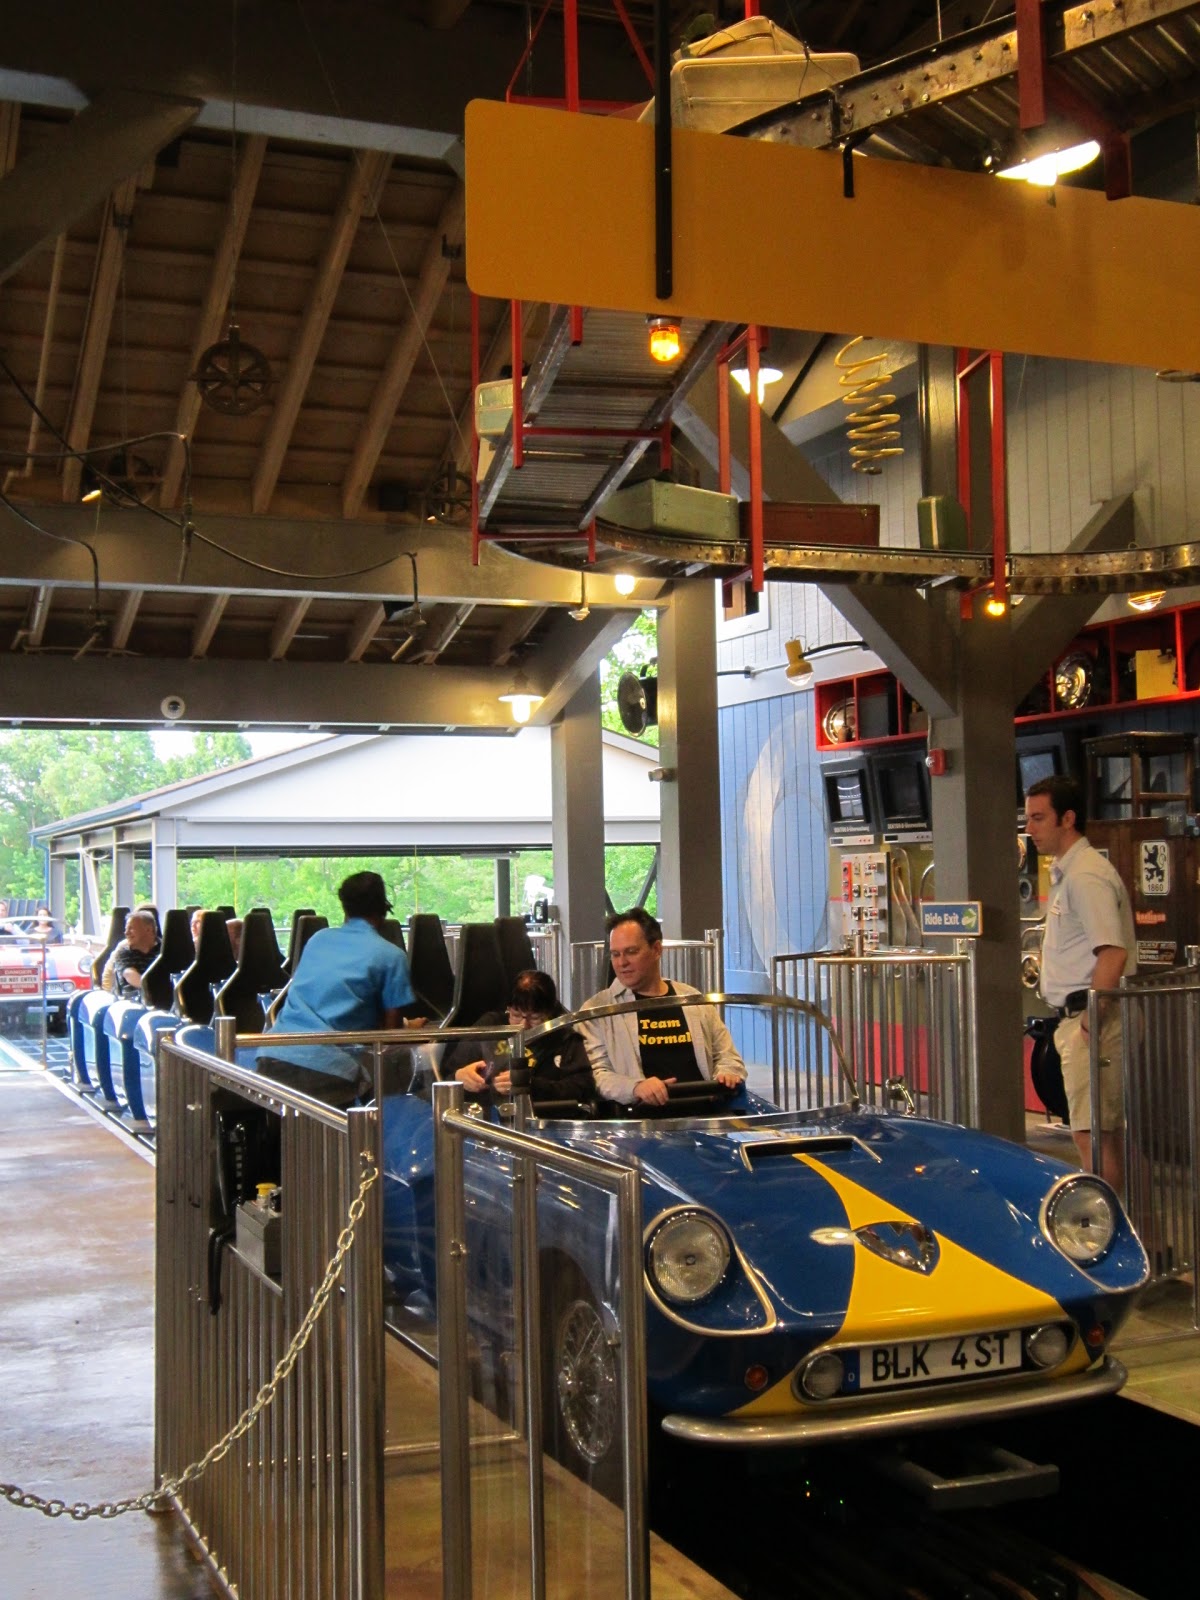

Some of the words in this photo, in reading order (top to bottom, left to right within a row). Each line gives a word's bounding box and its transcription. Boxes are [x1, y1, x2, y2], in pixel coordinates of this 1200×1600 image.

[1147, 883, 1164, 892] 1860
[924, 912, 942, 926] Ride
[943, 912, 960, 926] Exit
[640, 1019, 680, 1030] Team
[638, 1032, 692, 1045] Normal
[872, 1343, 931, 1382] BLK
